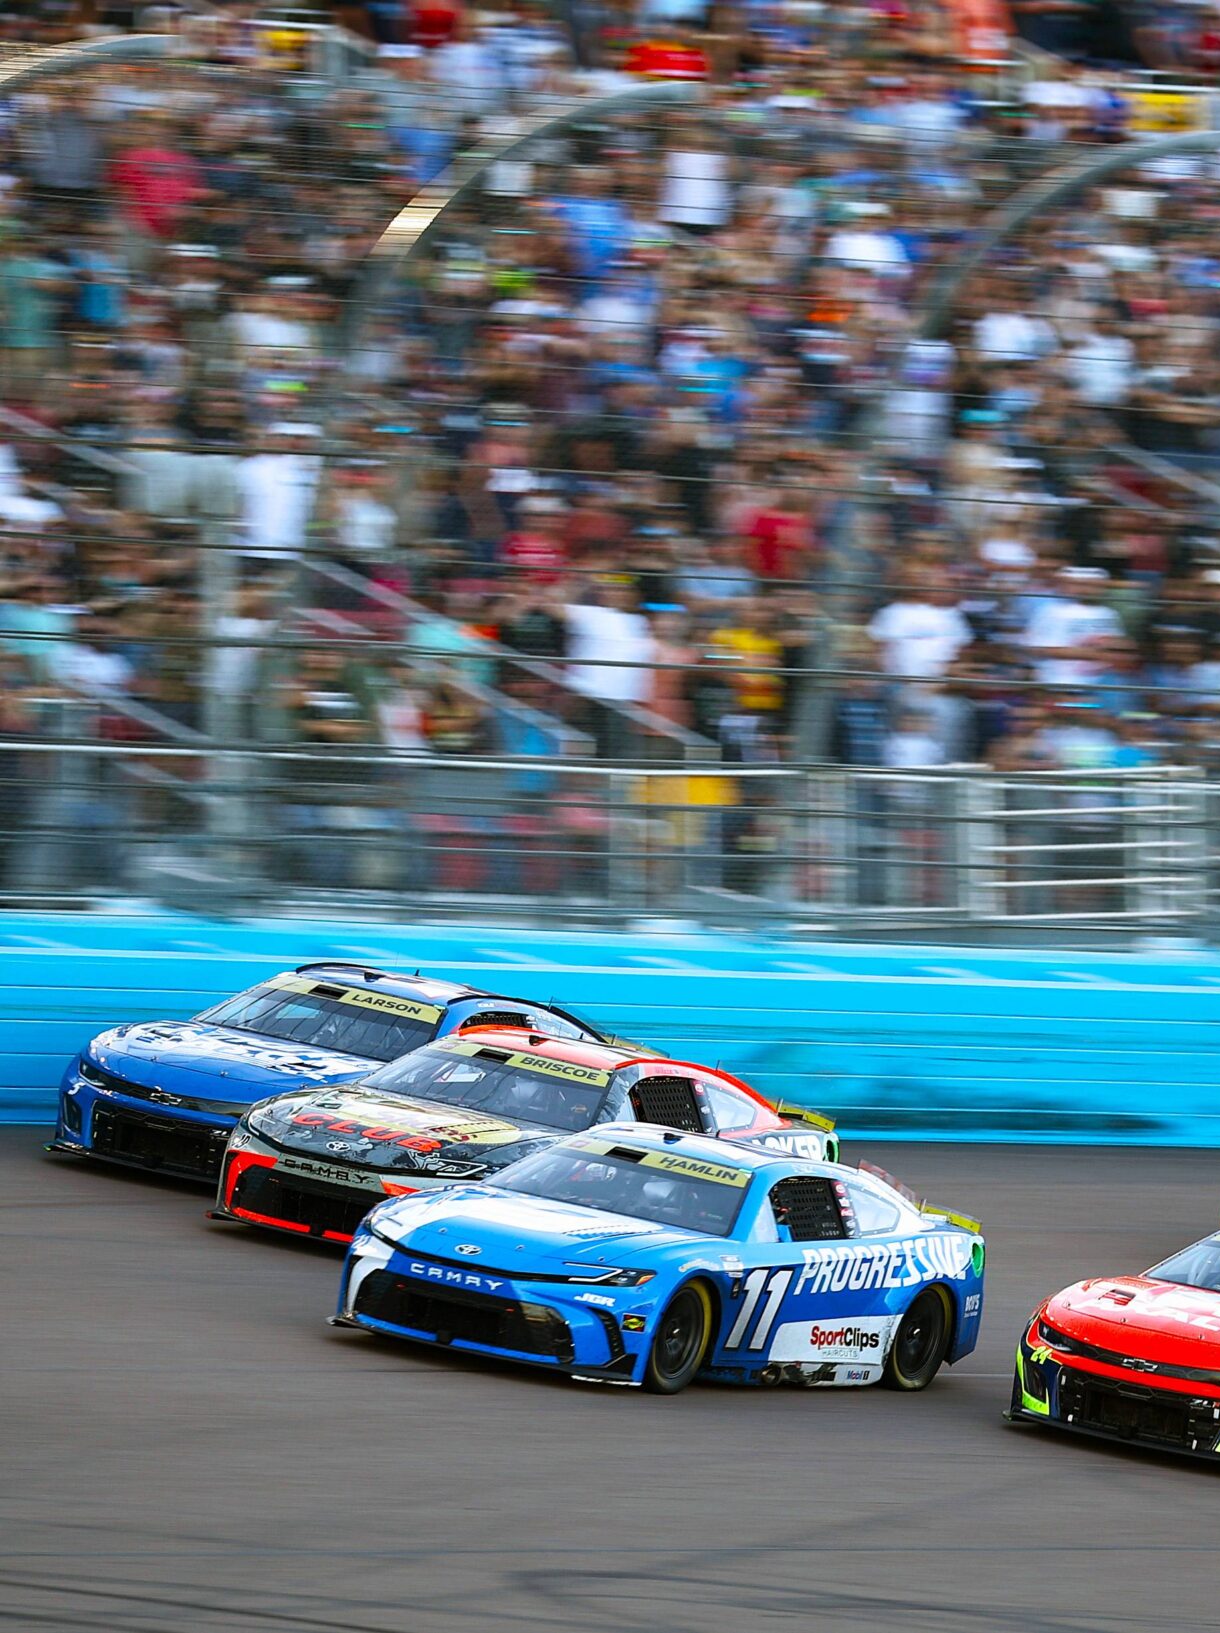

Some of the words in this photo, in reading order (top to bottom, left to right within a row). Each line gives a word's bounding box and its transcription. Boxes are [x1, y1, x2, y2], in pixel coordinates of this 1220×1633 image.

[351, 994, 422, 1015] LARSON
[519, 1056, 600, 1081] BRISCOE
[292, 1113, 443, 1152] CLUB
[751, 1135, 821, 1161] KER
[283, 1158, 373, 1184] CAMRY
[659, 1156, 739, 1181] HAMLIN
[410, 1262, 503, 1291] CAMRY
[793, 1235, 968, 1296] PROGRESSIVE
[724, 1269, 794, 1350] 11
